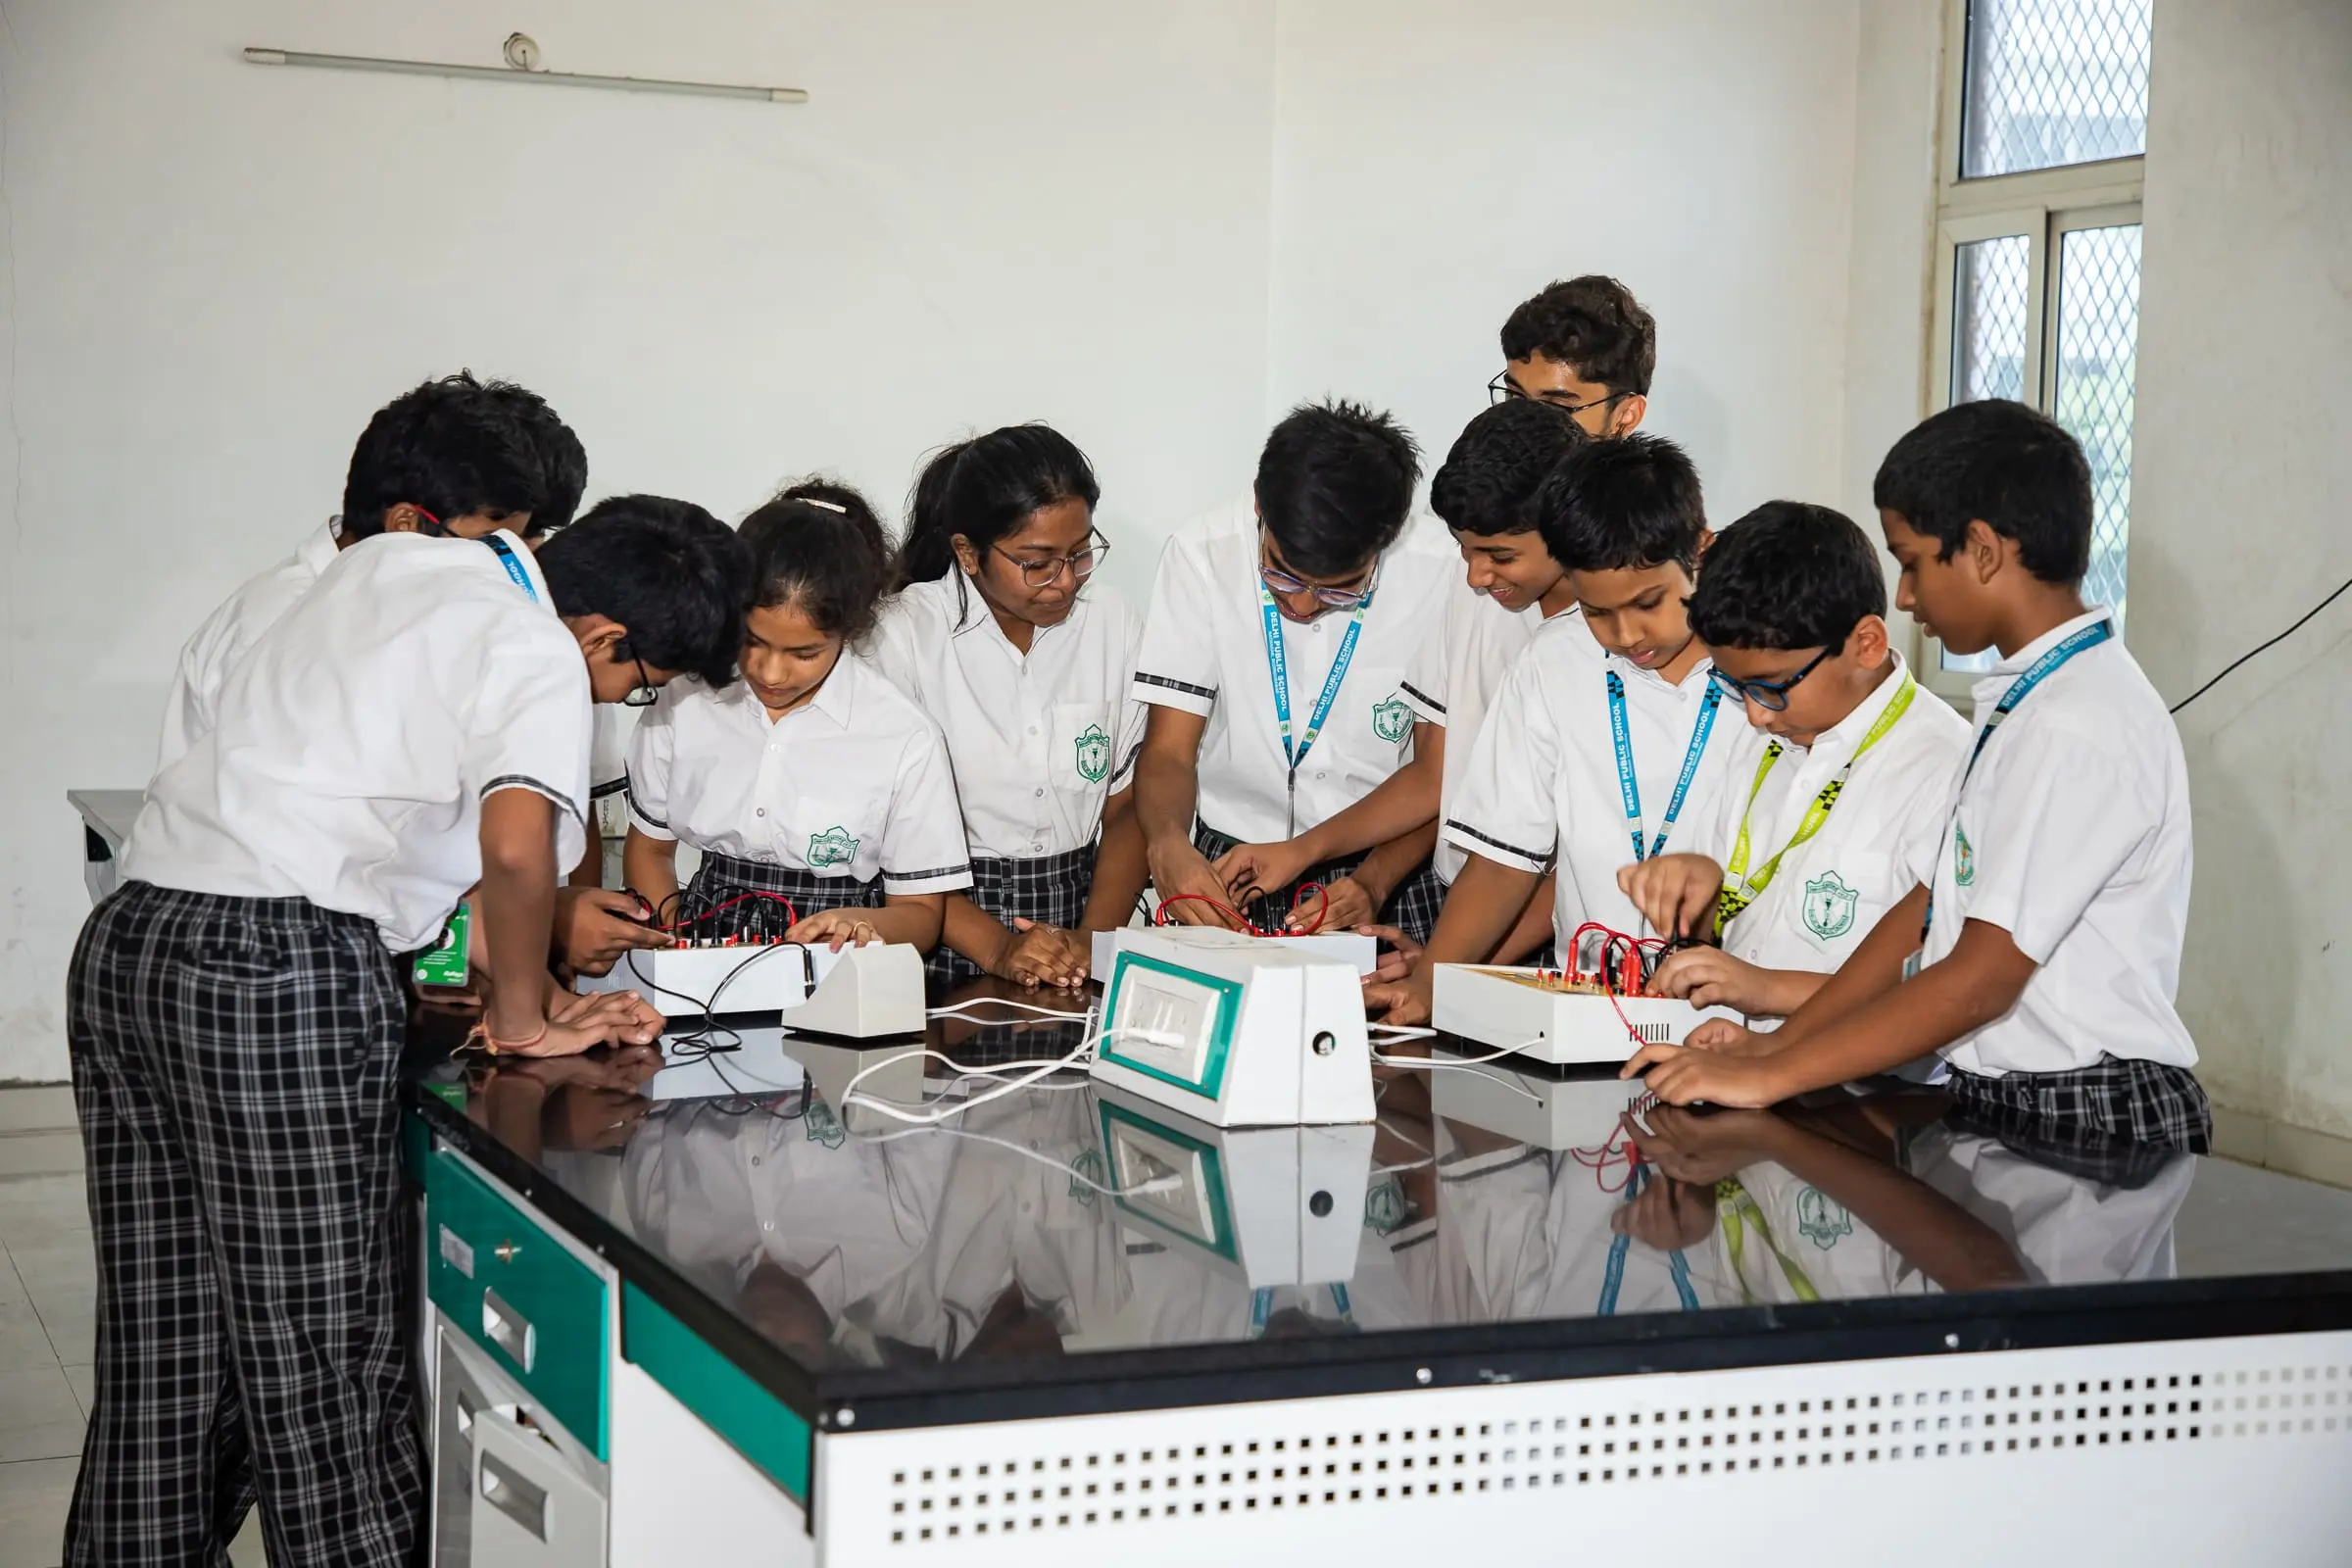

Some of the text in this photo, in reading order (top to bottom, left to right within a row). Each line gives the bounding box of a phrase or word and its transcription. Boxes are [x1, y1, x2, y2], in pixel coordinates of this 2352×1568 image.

[1270, 612, 1280, 638] DELHI
[1273, 640, 1284, 673] PUBLIC
[1313, 696, 1329, 721] DELHI
[1324, 663, 1342, 695] PUBLIC
[1338, 628, 1355, 662] SCHOOL
[2001, 680, 2027, 707] DELHI
[2026, 648, 2063, 682] PUBLIC
[2060, 626, 2099, 651] SCHOOL
[1277, 675, 1287, 711] SCHOOL
[1612, 702, 1624, 742] SCHOOL
[1618, 745, 1630, 779] PUBLIC
[1668, 784, 1683, 814] DELHI
[1679, 750, 1696, 786] PUBLIC
[1692, 710, 1710, 749] SCHOOL
[1623, 782, 1635, 811] DELHI
